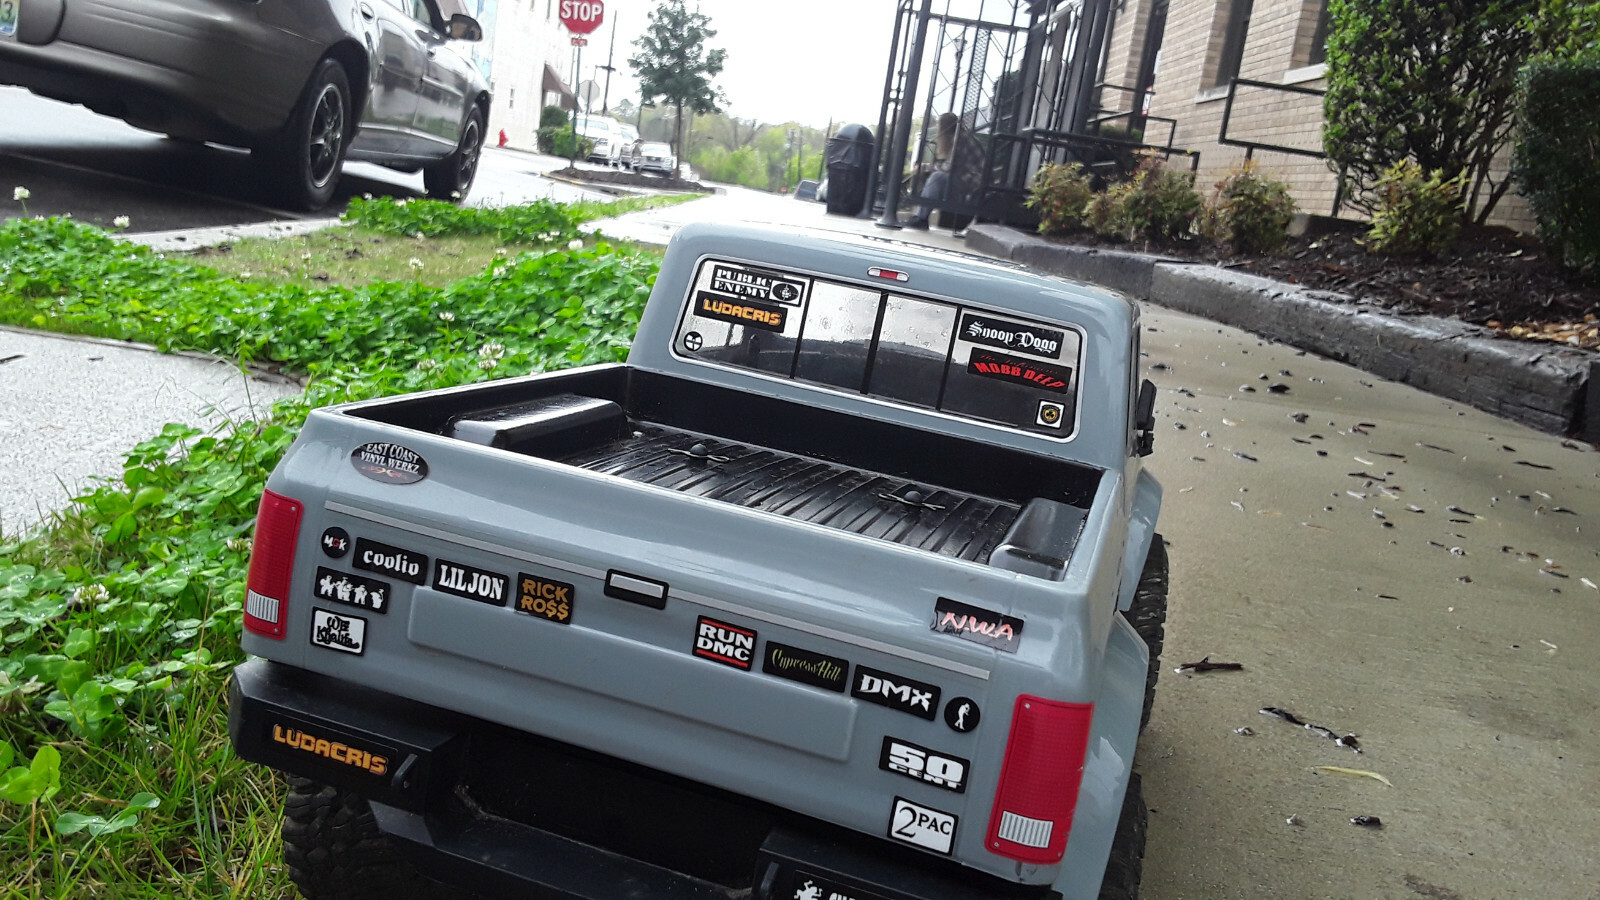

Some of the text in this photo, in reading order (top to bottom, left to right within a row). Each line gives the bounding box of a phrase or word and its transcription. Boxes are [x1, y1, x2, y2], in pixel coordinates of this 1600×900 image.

[560, 0, 602, 22] STOP
[714, 280, 769, 298] ENEMY
[716, 268, 772, 287] PUBLIC
[703, 299, 782, 326] LUDACRIS
[966, 321, 1057, 353] Snoop Dogg
[974, 362, 1022, 377] MOBB
[1023, 369, 1066, 388] DEEP
[360, 451, 420, 474] VINYL WERKZ
[366, 443, 419, 463] EAST COAST
[324, 535, 347, 551] MGK
[522, 578, 569, 603] RICK
[697, 637, 750, 661] DMC
[699, 623, 754, 650] RUN
[817, 659, 841, 682] Hill
[858, 674, 933, 712] DMX
[273, 723, 389, 776] LUDACRIS
[889, 742, 964, 782] 50
[888, 762, 961, 789] CENT
[895, 806, 952, 838] 2PAC
